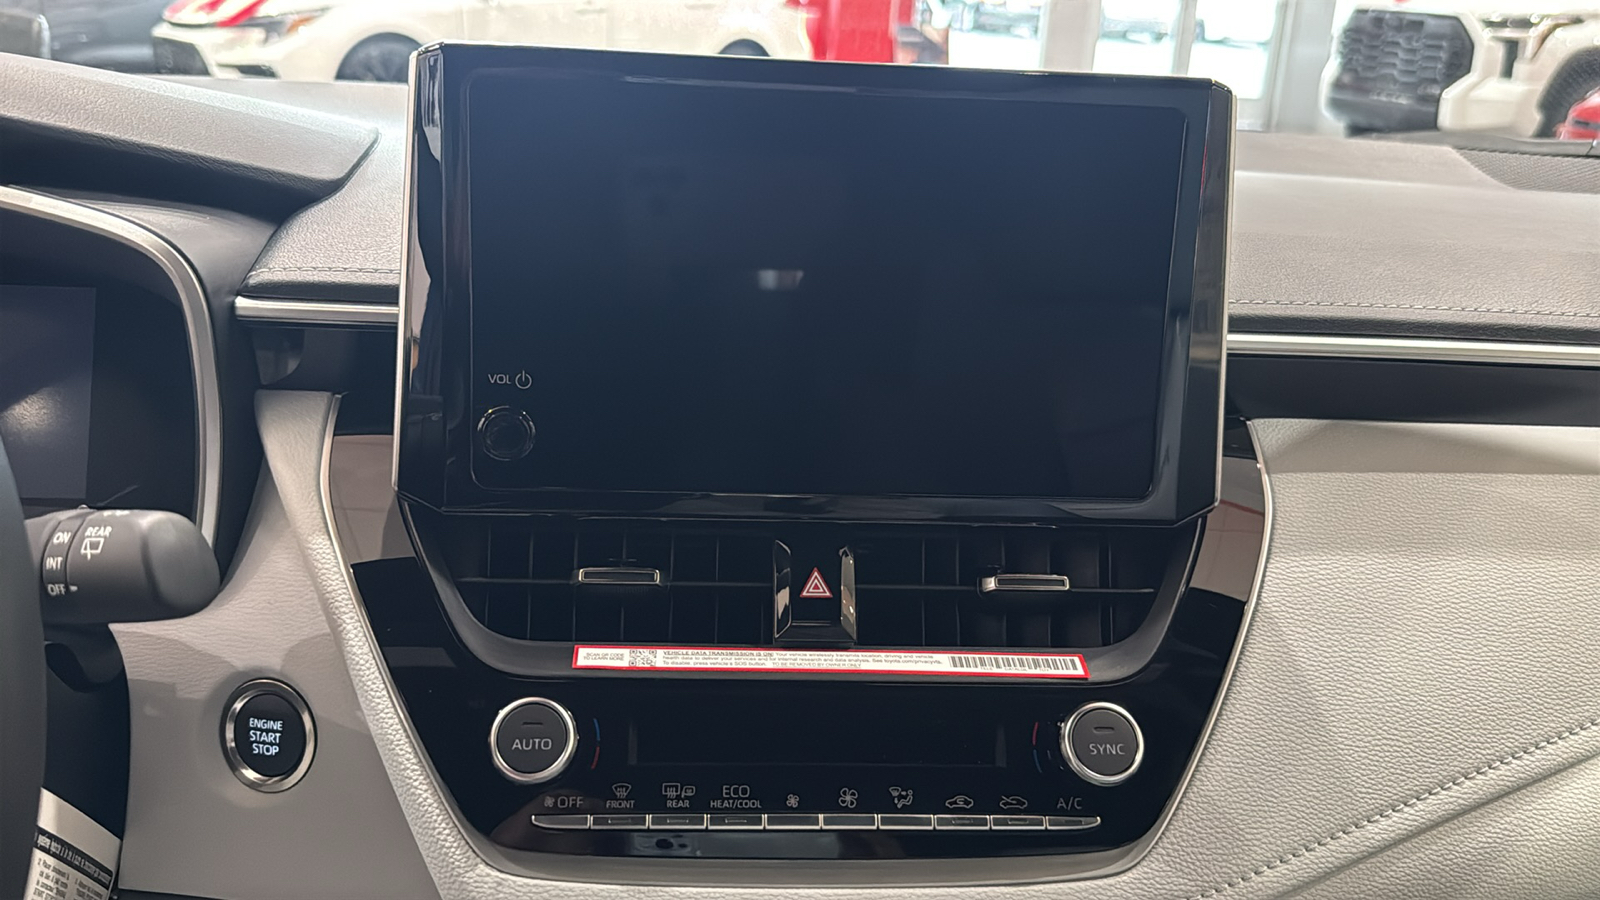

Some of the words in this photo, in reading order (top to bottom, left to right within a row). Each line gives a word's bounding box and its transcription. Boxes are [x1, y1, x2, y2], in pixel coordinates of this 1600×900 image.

[488, 374, 511, 384] VOL
[53, 532, 71, 544] ON
[84, 526, 112, 538] REAR
[46, 556, 63, 571] INT
[47, 583, 66, 596] OFF
[249, 717, 283, 730] ENGINE
[250, 730, 281, 743] START
[252, 743, 279, 755] STOP
[511, 738, 552, 751] AUTO
[1089, 743, 1125, 755] SYNC
[722, 785, 750, 798] ECO
[557, 796, 584, 809] OFF
[606, 800, 635, 809] FRONT
[666, 800, 690, 808] REAR
[710, 800, 762, 809] HEAT/COOL
[1056, 796, 1083, 810] A/C
